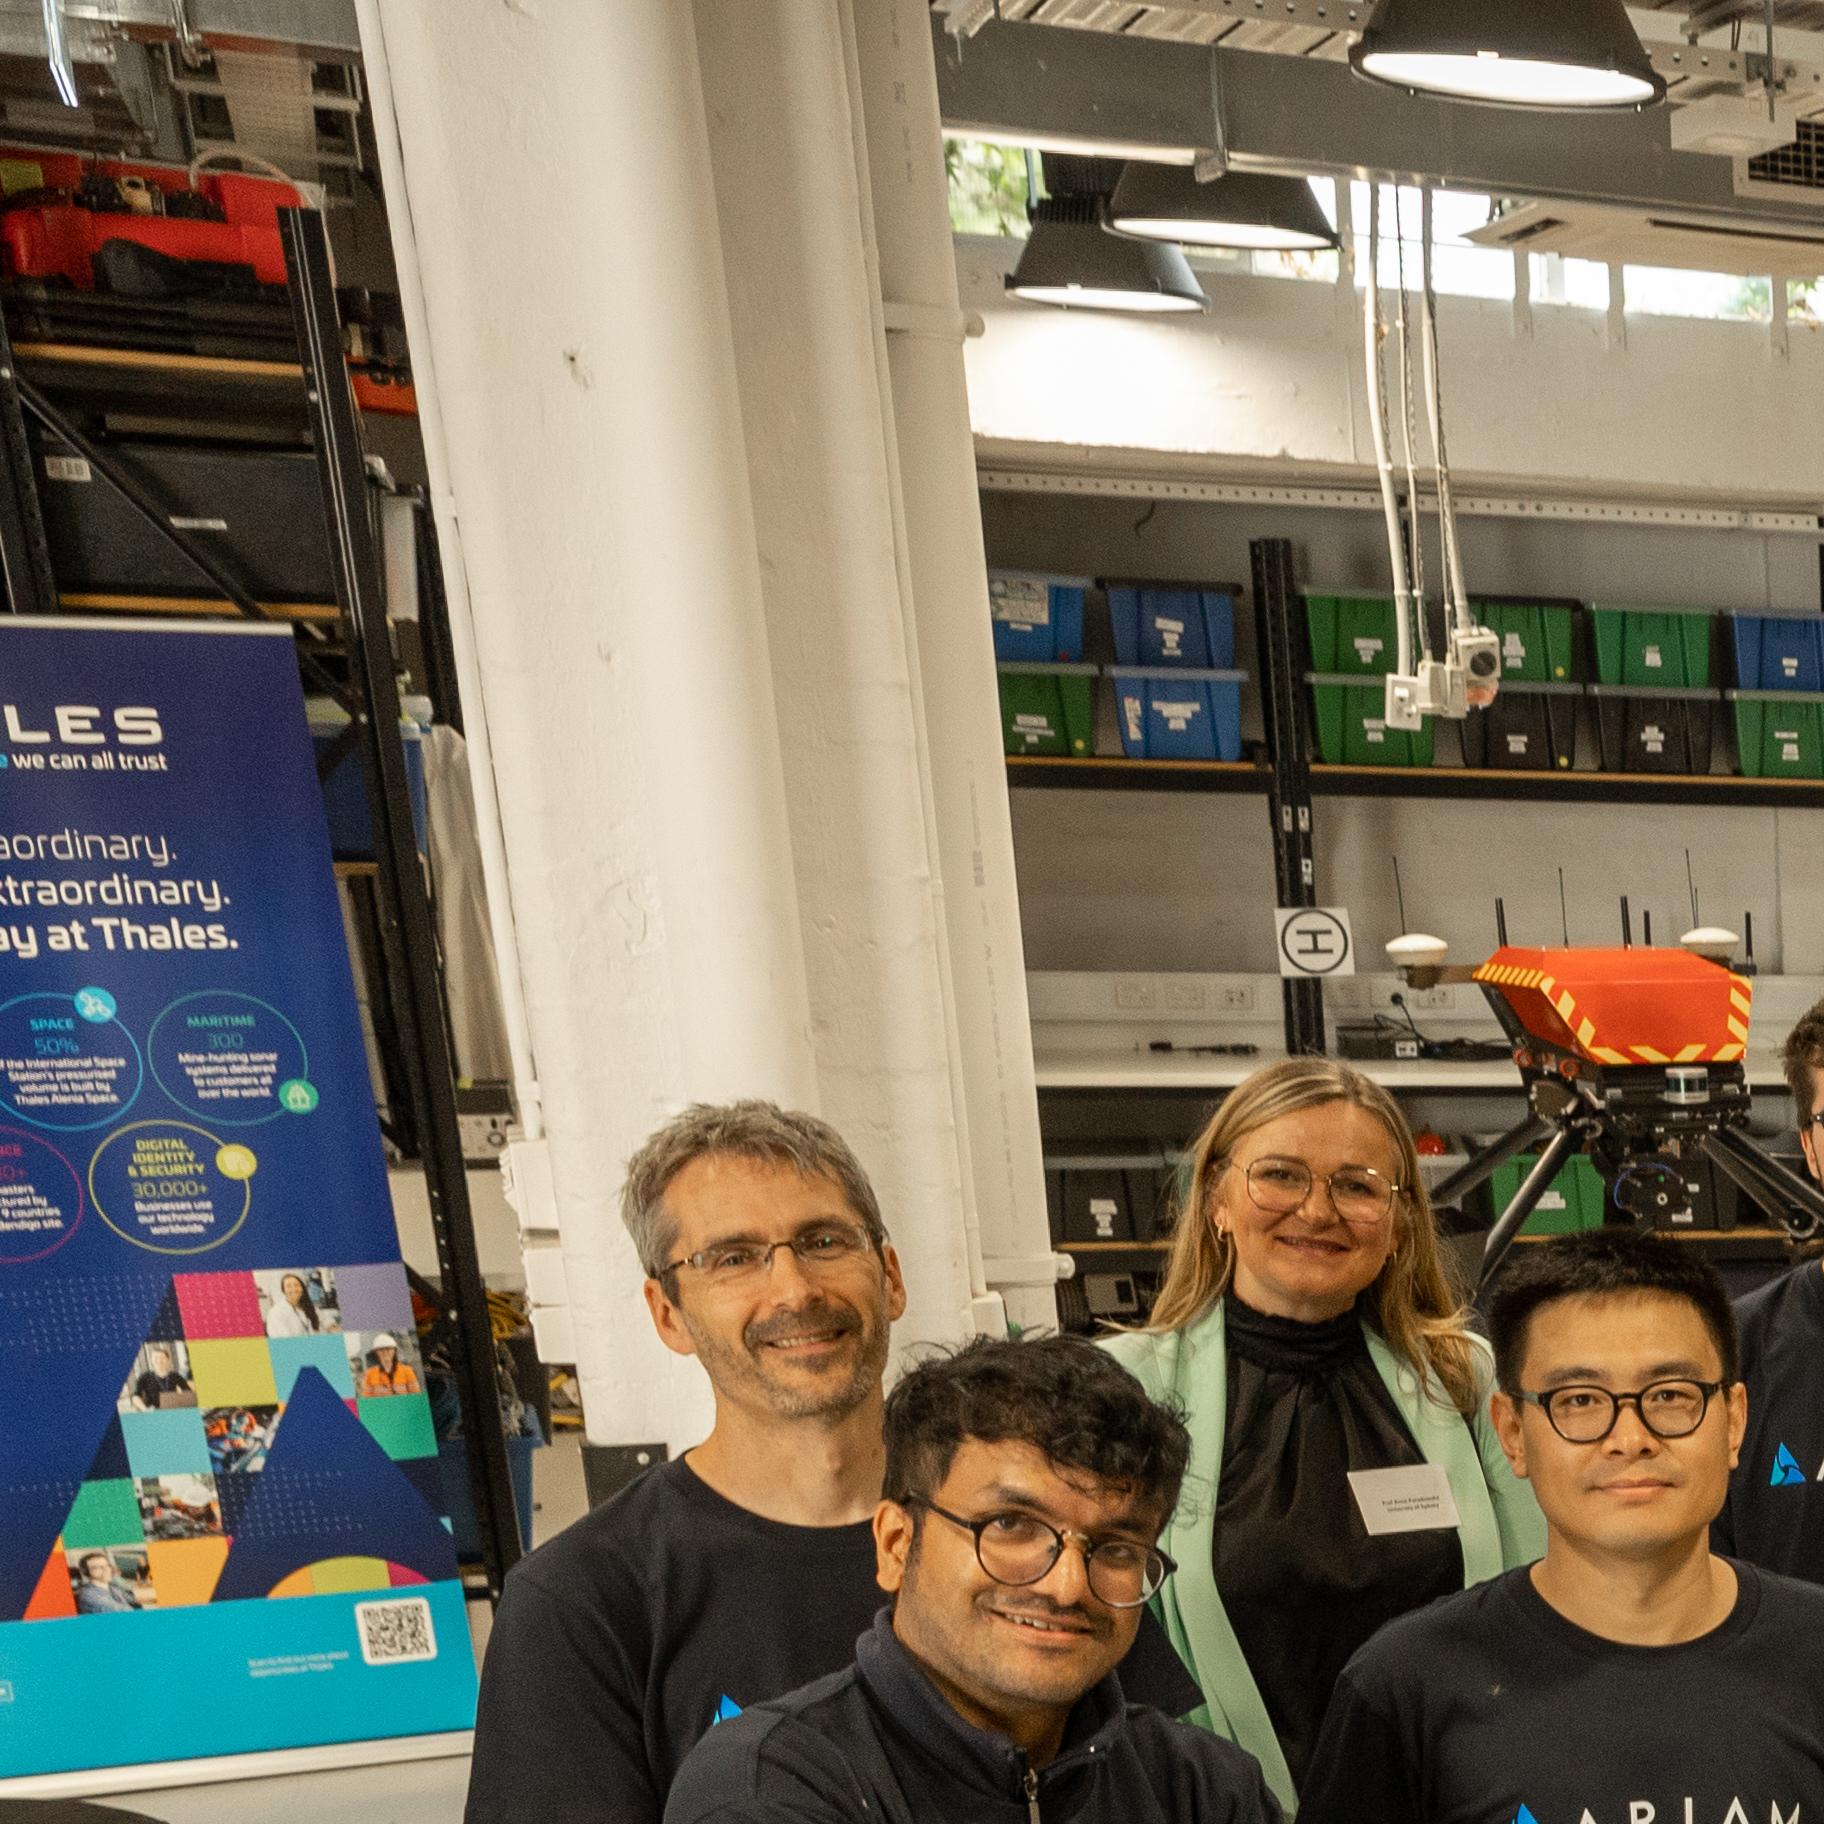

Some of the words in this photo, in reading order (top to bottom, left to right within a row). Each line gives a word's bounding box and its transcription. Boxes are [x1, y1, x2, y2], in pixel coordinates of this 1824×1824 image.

[3, 704, 163, 745] LES
[12, 753, 45, 770] we
[50, 753, 87, 770] can
[91, 750, 115, 770] all
[118, 752, 168, 771] trust
[47, 919, 90, 951] at
[91, 916, 239, 951] Thales.
[30, 1017, 75, 1031] SPACE
[186, 1014, 256, 1027] MARITIME
[34, 1036, 80, 1055] 50%
[135, 1139, 188, 1151] DIGITAL
[132, 1151, 196, 1164] IDENTITY
[140, 1163, 205, 1177] SECURITY
